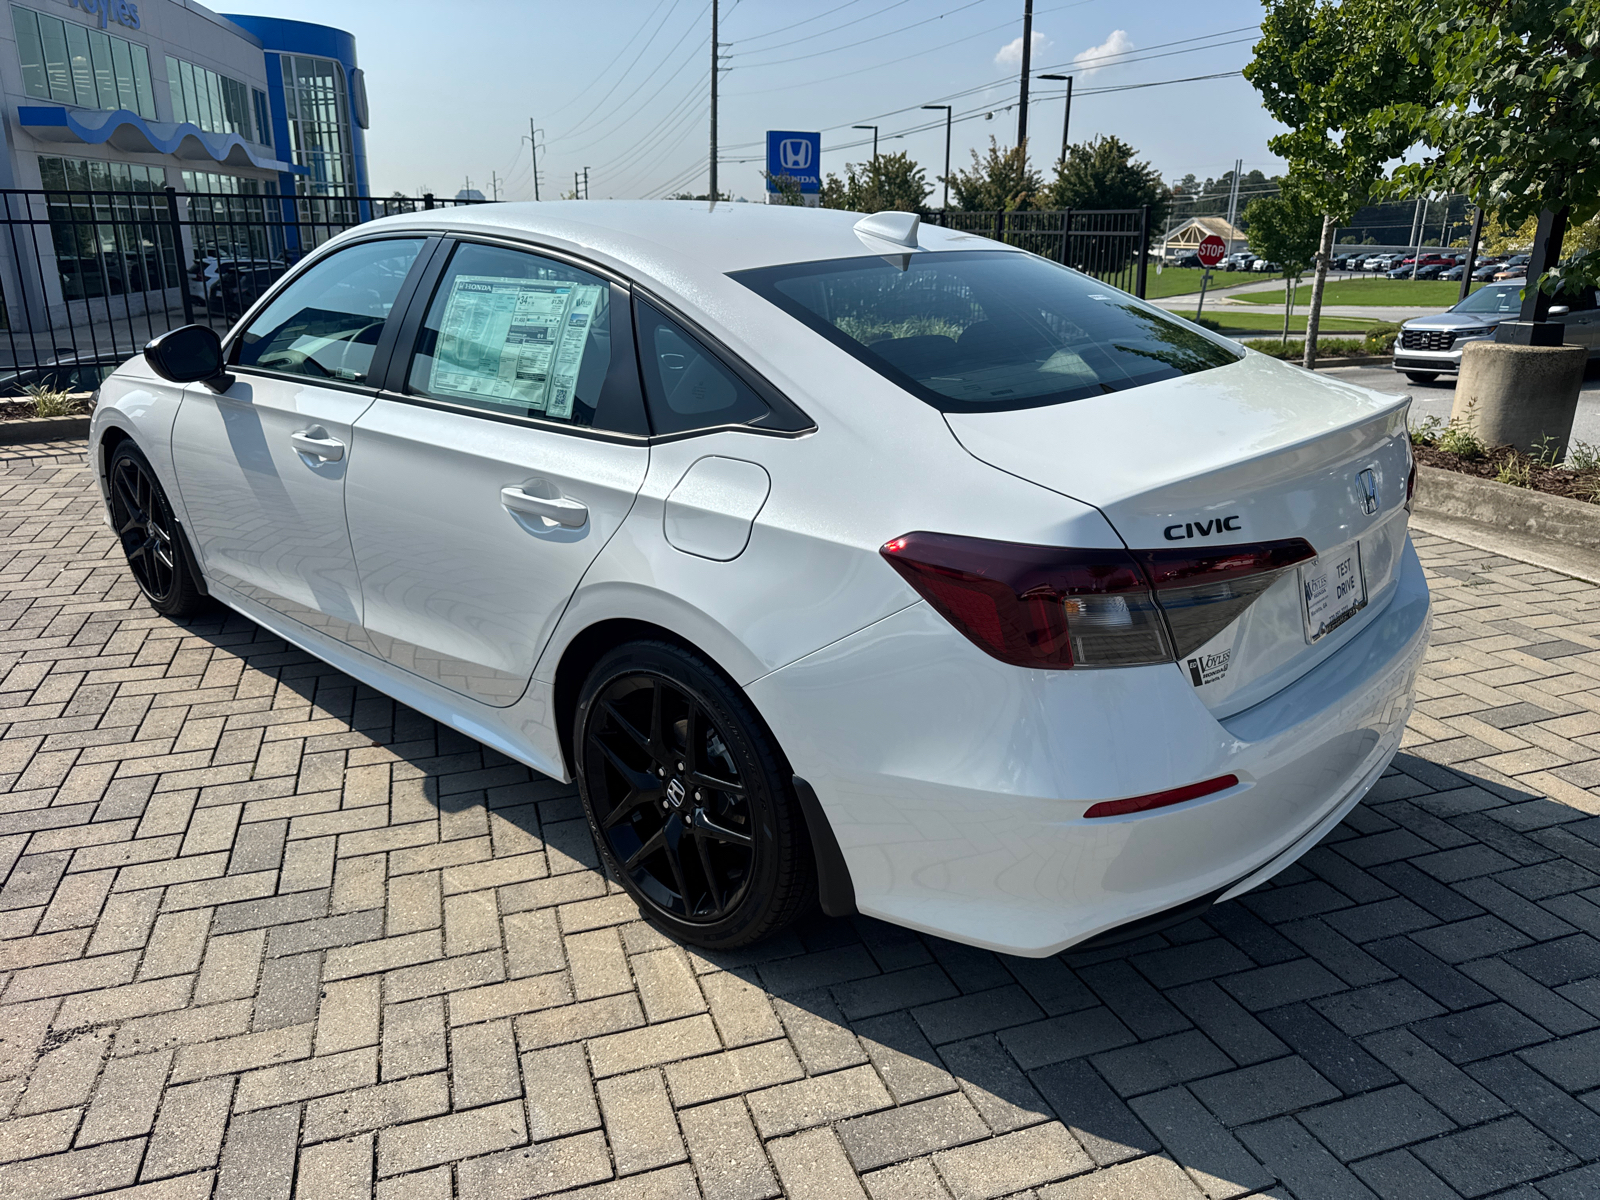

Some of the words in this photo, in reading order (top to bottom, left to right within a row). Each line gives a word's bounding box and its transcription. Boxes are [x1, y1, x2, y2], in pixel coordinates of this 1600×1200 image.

[72, 0, 140, 29] oyles
[1200, 244, 1224, 257] STOP
[465, 283, 492, 291] HONDA
[519, 295, 528, 304] 34
[1164, 515, 1241, 541] CIVIC
[1336, 557, 1351, 578] TEST
[1336, 575, 1355, 600] DRIVE
[1198, 651, 1231, 673] VOYLES
[1203, 668, 1224, 679] HONDA
